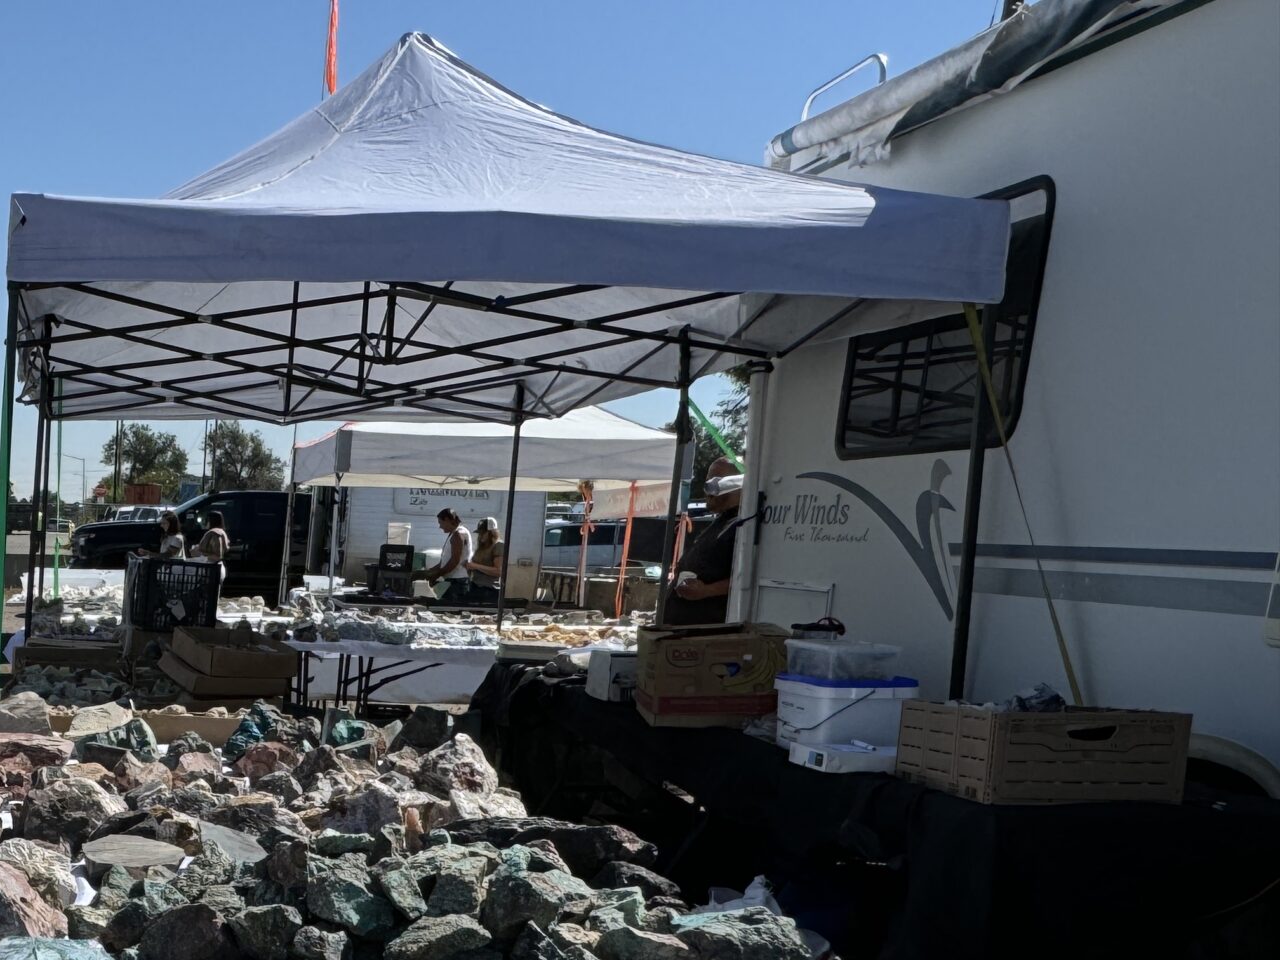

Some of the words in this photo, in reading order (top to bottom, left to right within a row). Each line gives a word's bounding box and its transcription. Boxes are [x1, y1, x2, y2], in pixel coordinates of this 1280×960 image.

[762, 503, 792, 525] our
[794, 494, 850, 525] Winds
[811, 526, 870, 543] Thousand
[671, 648, 698, 660] Dole
